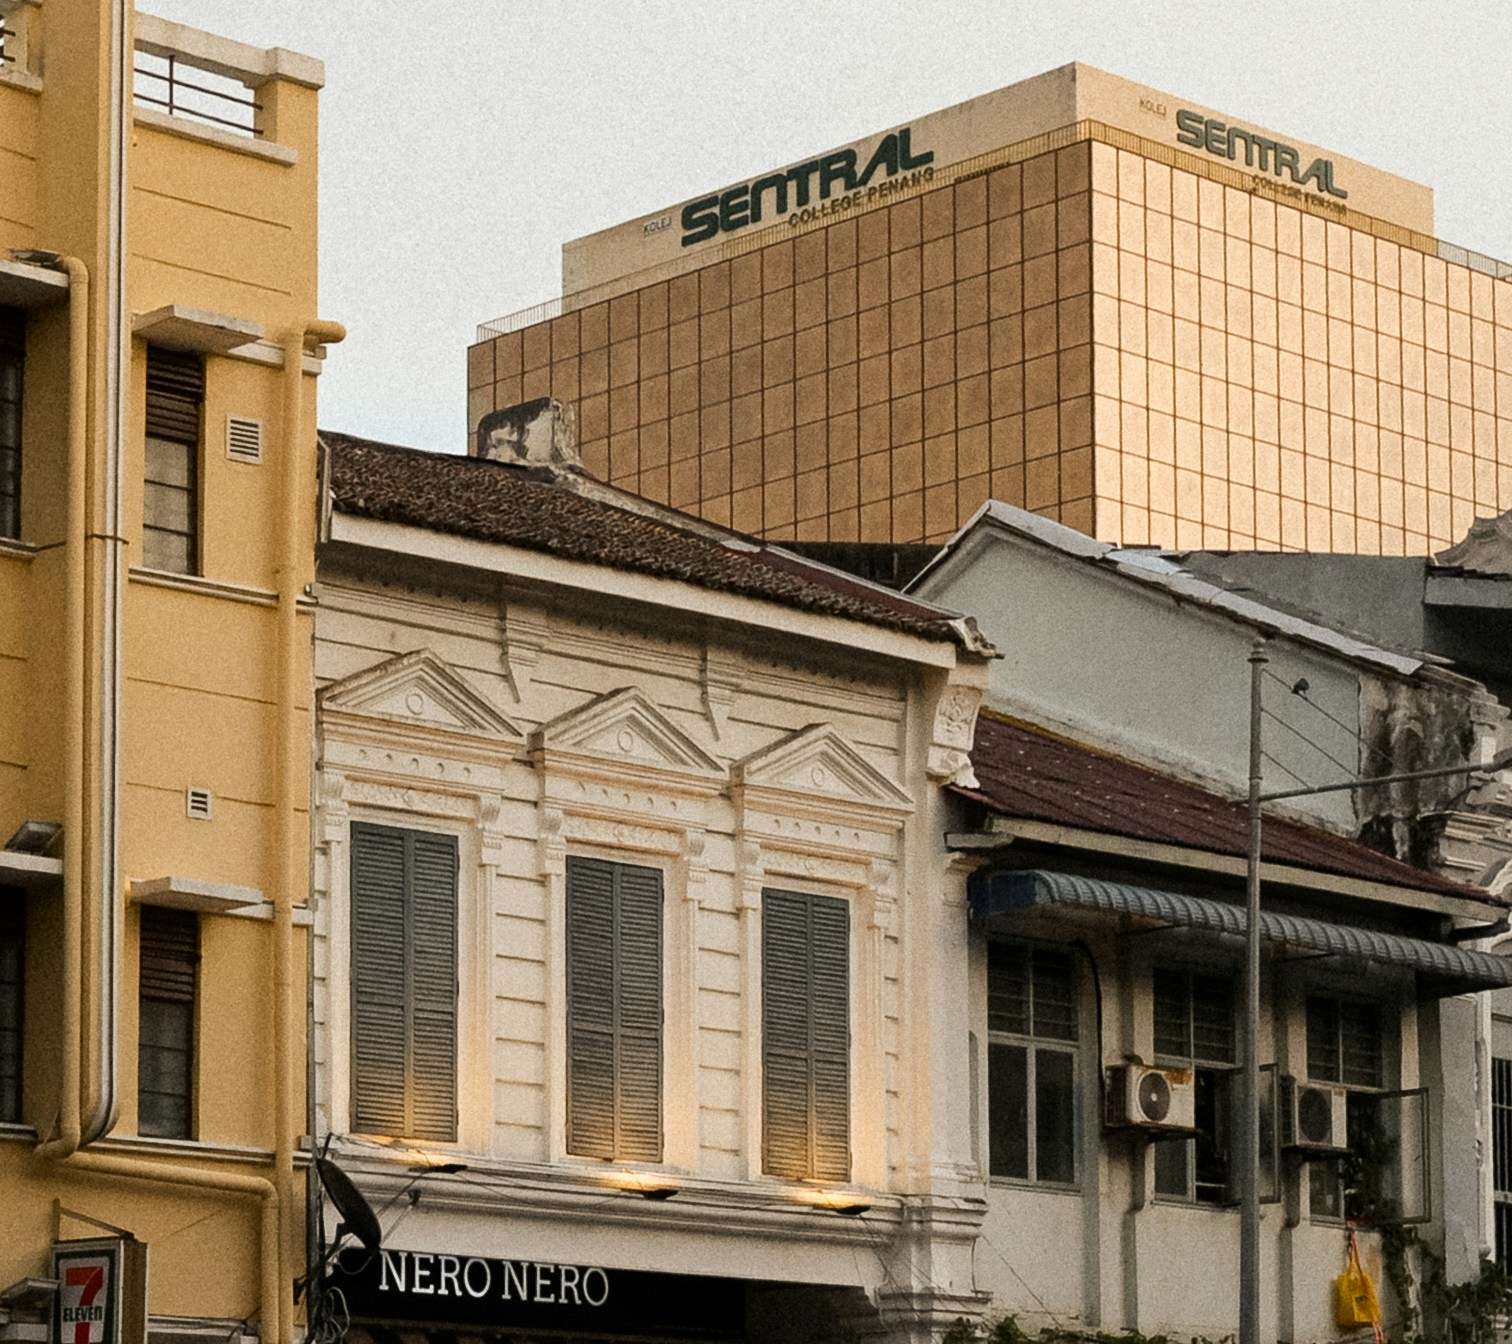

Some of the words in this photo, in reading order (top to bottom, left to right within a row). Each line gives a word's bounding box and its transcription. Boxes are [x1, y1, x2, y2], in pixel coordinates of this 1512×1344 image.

[681, 127, 935, 247] SENTRAL
[1176, 108, 1349, 199] SENTRAL
[642, 216, 673, 237] KOLEJ
[788, 191, 862, 228] COLLEGE
[867, 166, 935, 202] PENANG
[65, 1266, 104, 1344] 7
[377, 1252, 492, 1301] NERO
[502, 1259, 611, 1309] NERO
